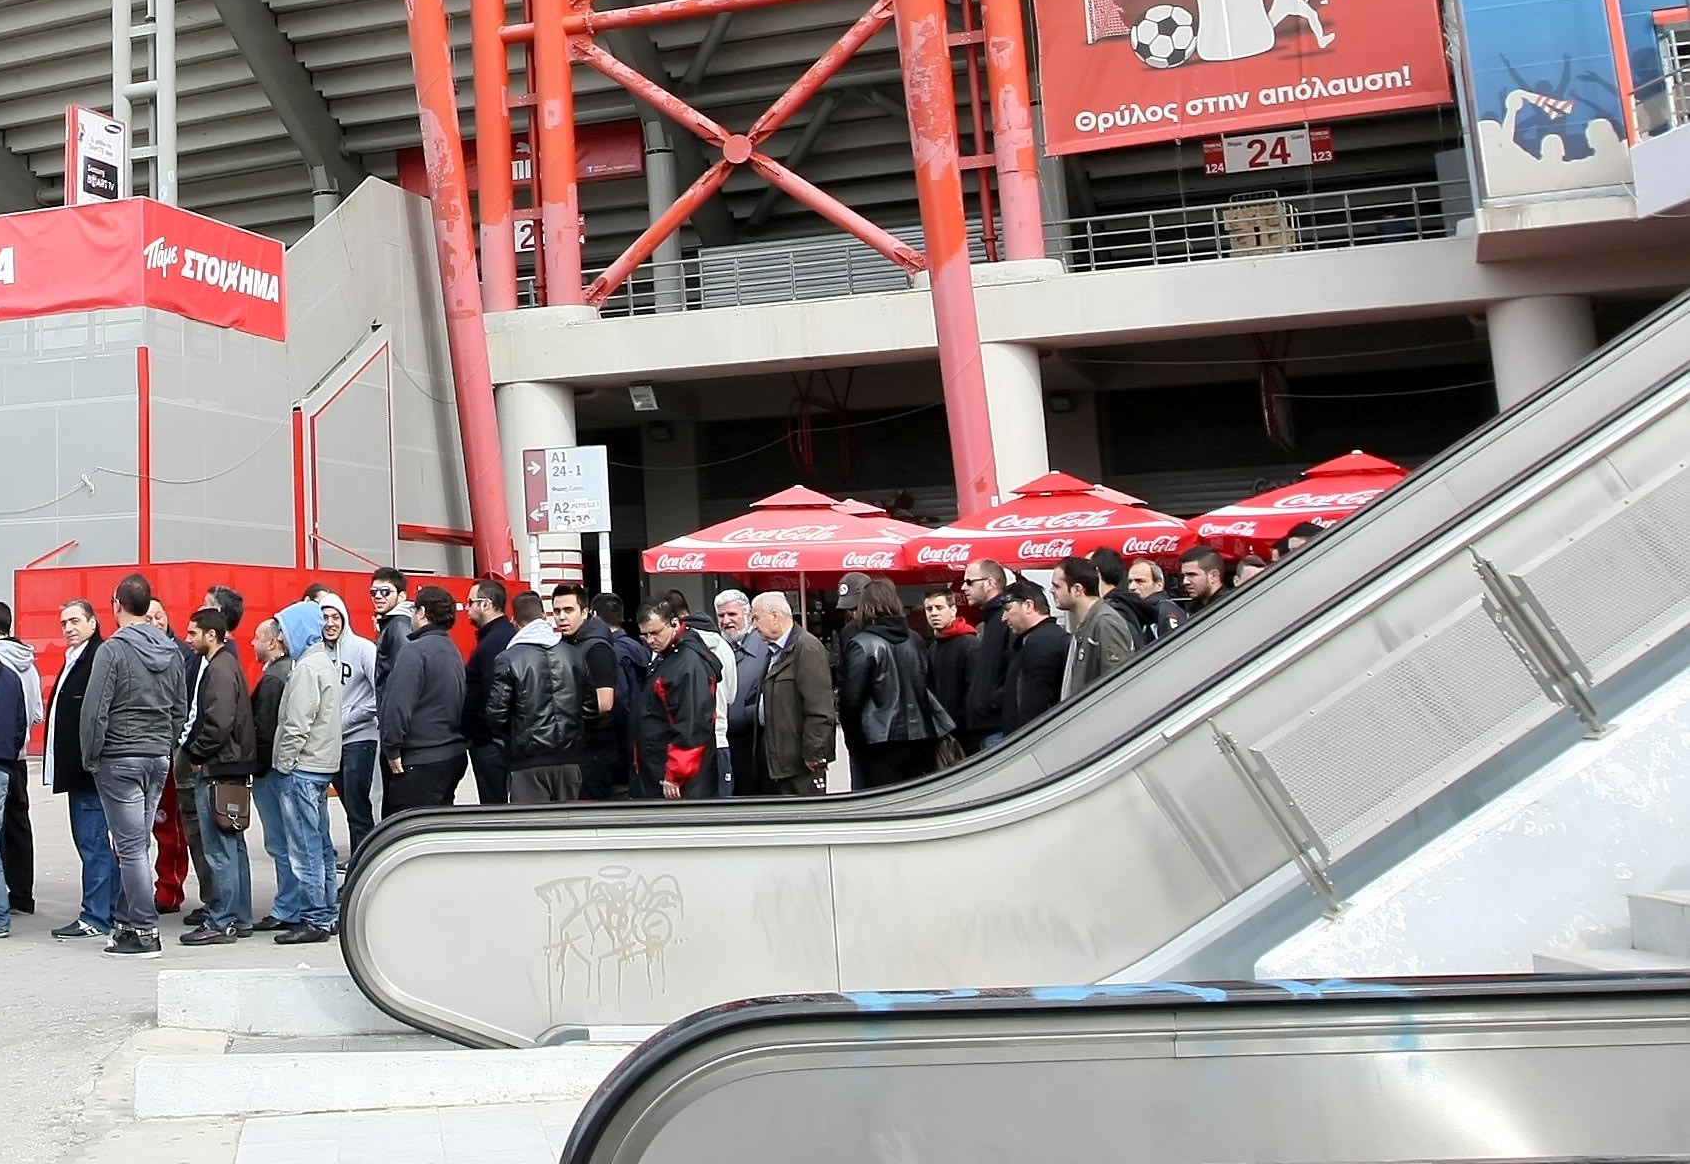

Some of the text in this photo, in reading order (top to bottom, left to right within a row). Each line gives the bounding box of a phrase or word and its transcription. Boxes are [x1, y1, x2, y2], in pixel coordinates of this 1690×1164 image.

[1074, 65, 1412, 133] Θρύλος στην απόλαυση!
[1247, 136, 1291, 168] 24
[1313, 151, 1333, 163] 123
[1205, 163, 1225, 175] 124
[143, 236, 279, 303] Πάμε ΣΤΟΙΧΗΜΑ
[551, 451, 566, 463] A1
[554, 502, 570, 514] A2
[986, 509, 1116, 531] Coca-Cola
[656, 553, 706, 571] Coca-Cola
[747, 551, 800, 569] Coca-Cola
[842, 551, 895, 569] Coca-Cola
[918, 544, 972, 564] Coca-Cola
